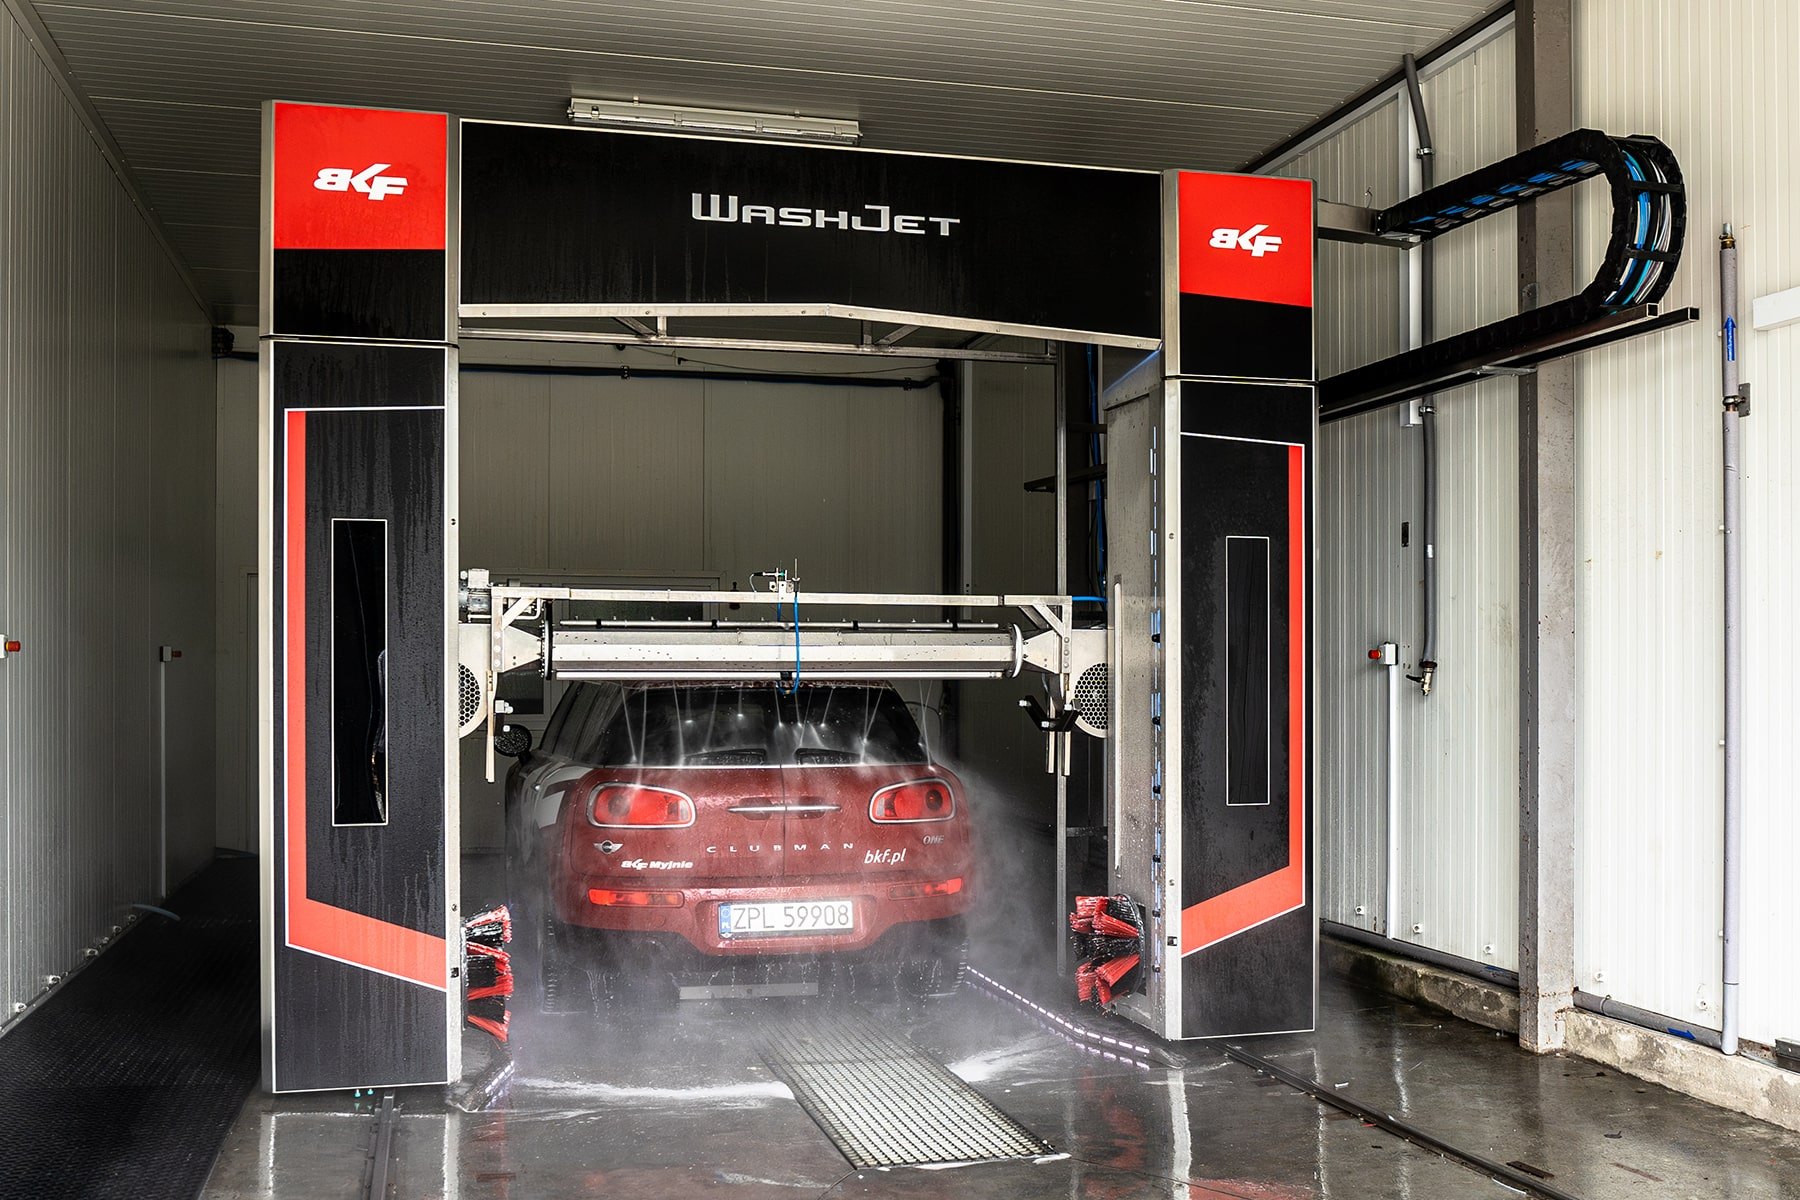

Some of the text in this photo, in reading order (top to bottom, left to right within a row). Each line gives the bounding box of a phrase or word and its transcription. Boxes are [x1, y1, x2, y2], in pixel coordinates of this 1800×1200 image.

[706, 842, 854, 853] CLUBMAN
[923, 835, 945, 845] ONE
[864, 847, 907, 866] bkf.pl
[733, 904, 849, 930] ZPL 59908
